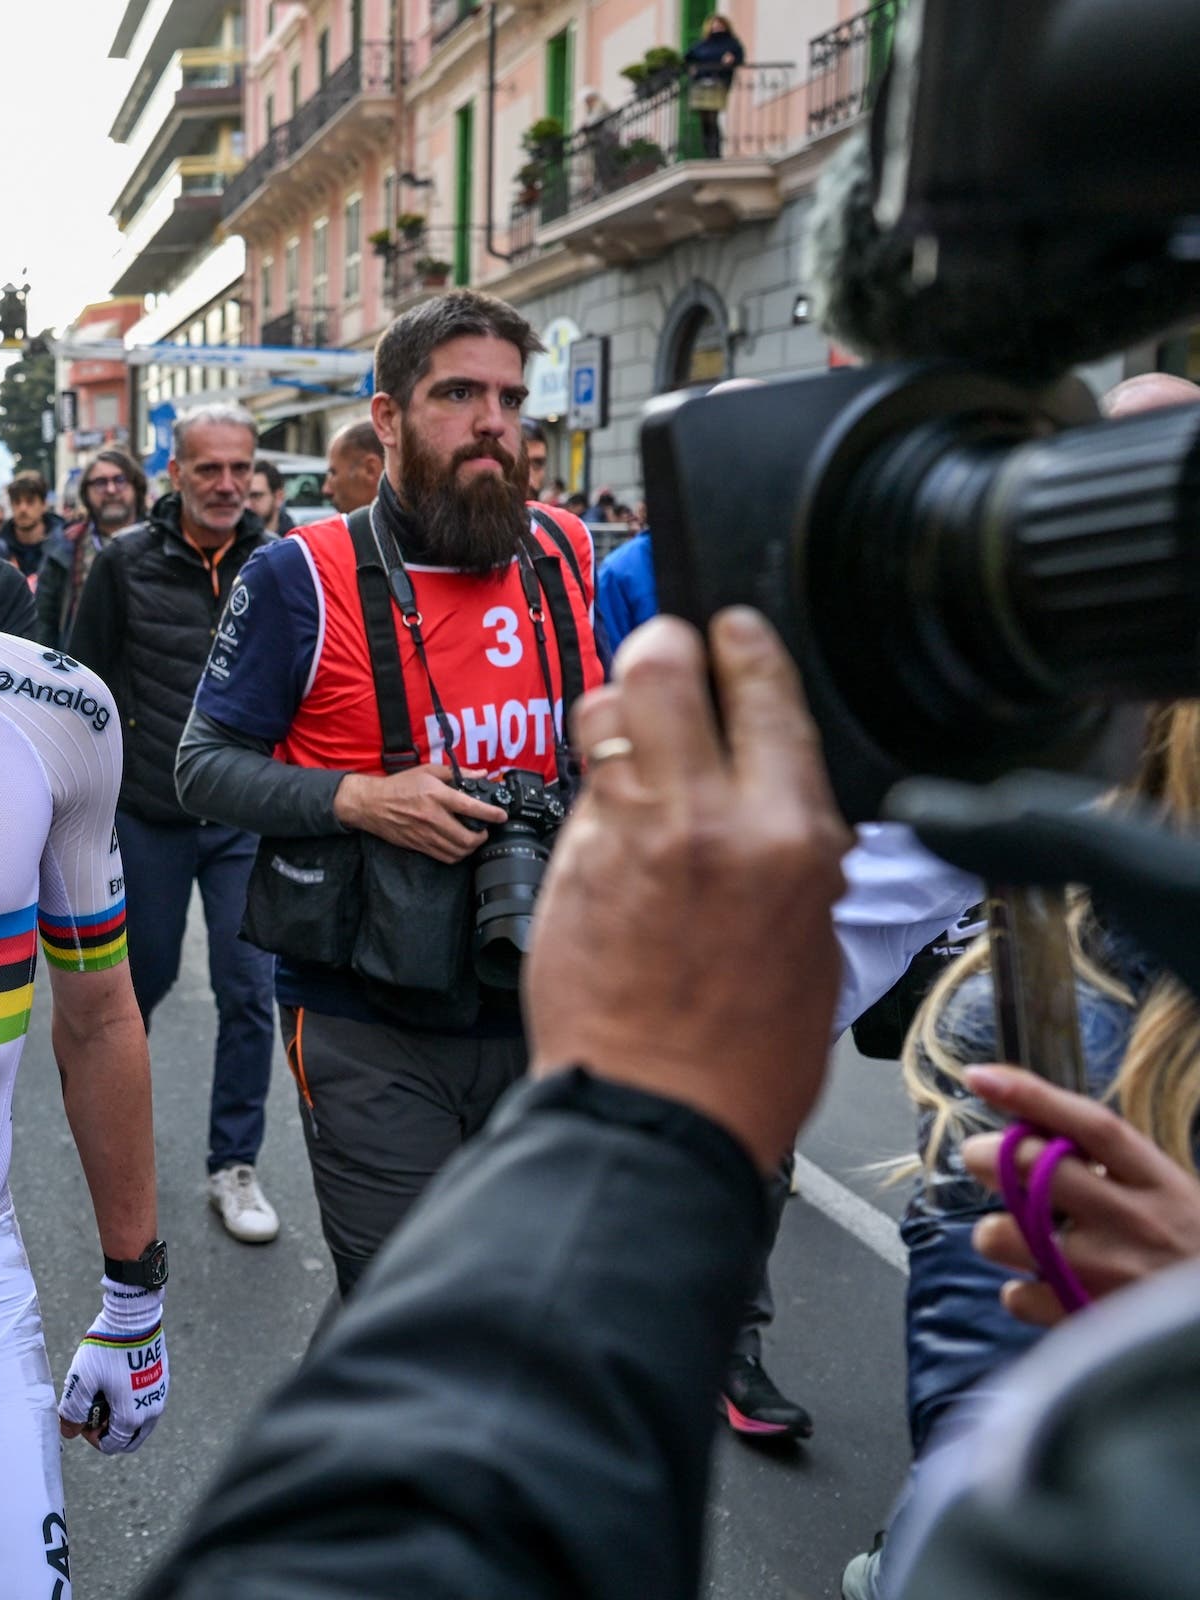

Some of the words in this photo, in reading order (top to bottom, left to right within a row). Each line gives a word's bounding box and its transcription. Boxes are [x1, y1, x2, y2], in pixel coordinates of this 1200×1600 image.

[579, 372, 592, 398] P
[482, 606, 523, 668] 3
[14, 677, 111, 731] Analog
[127, 1338, 162, 1370] UAE
